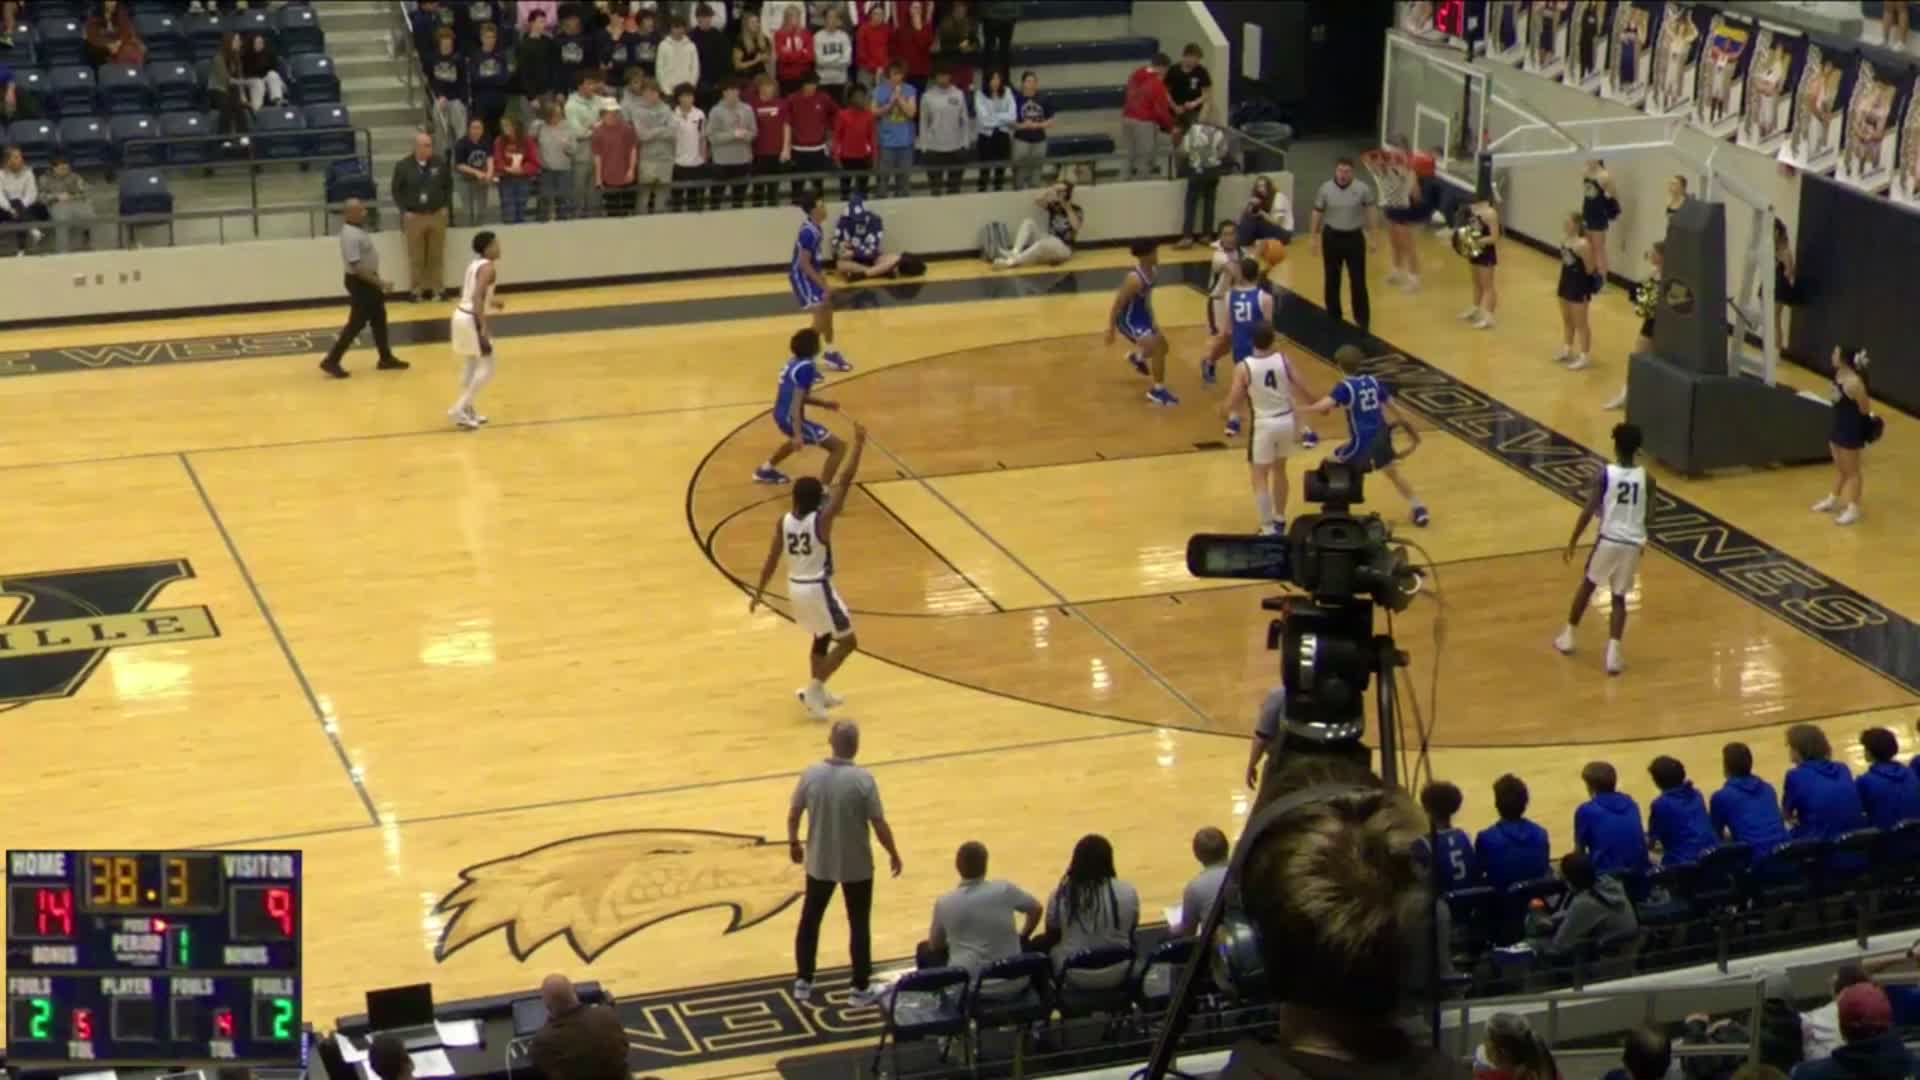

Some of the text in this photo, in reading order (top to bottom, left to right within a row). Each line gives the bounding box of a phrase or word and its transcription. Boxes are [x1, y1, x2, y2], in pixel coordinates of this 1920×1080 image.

[1234, 301, 1251, 321] 21
[1264, 370, 1277, 390] 4
[1359, 387, 1378, 411] 23
[1617, 482, 1638, 504] 21
[787, 532, 812, 555] 23
[1449, 849, 1467, 881] 5
